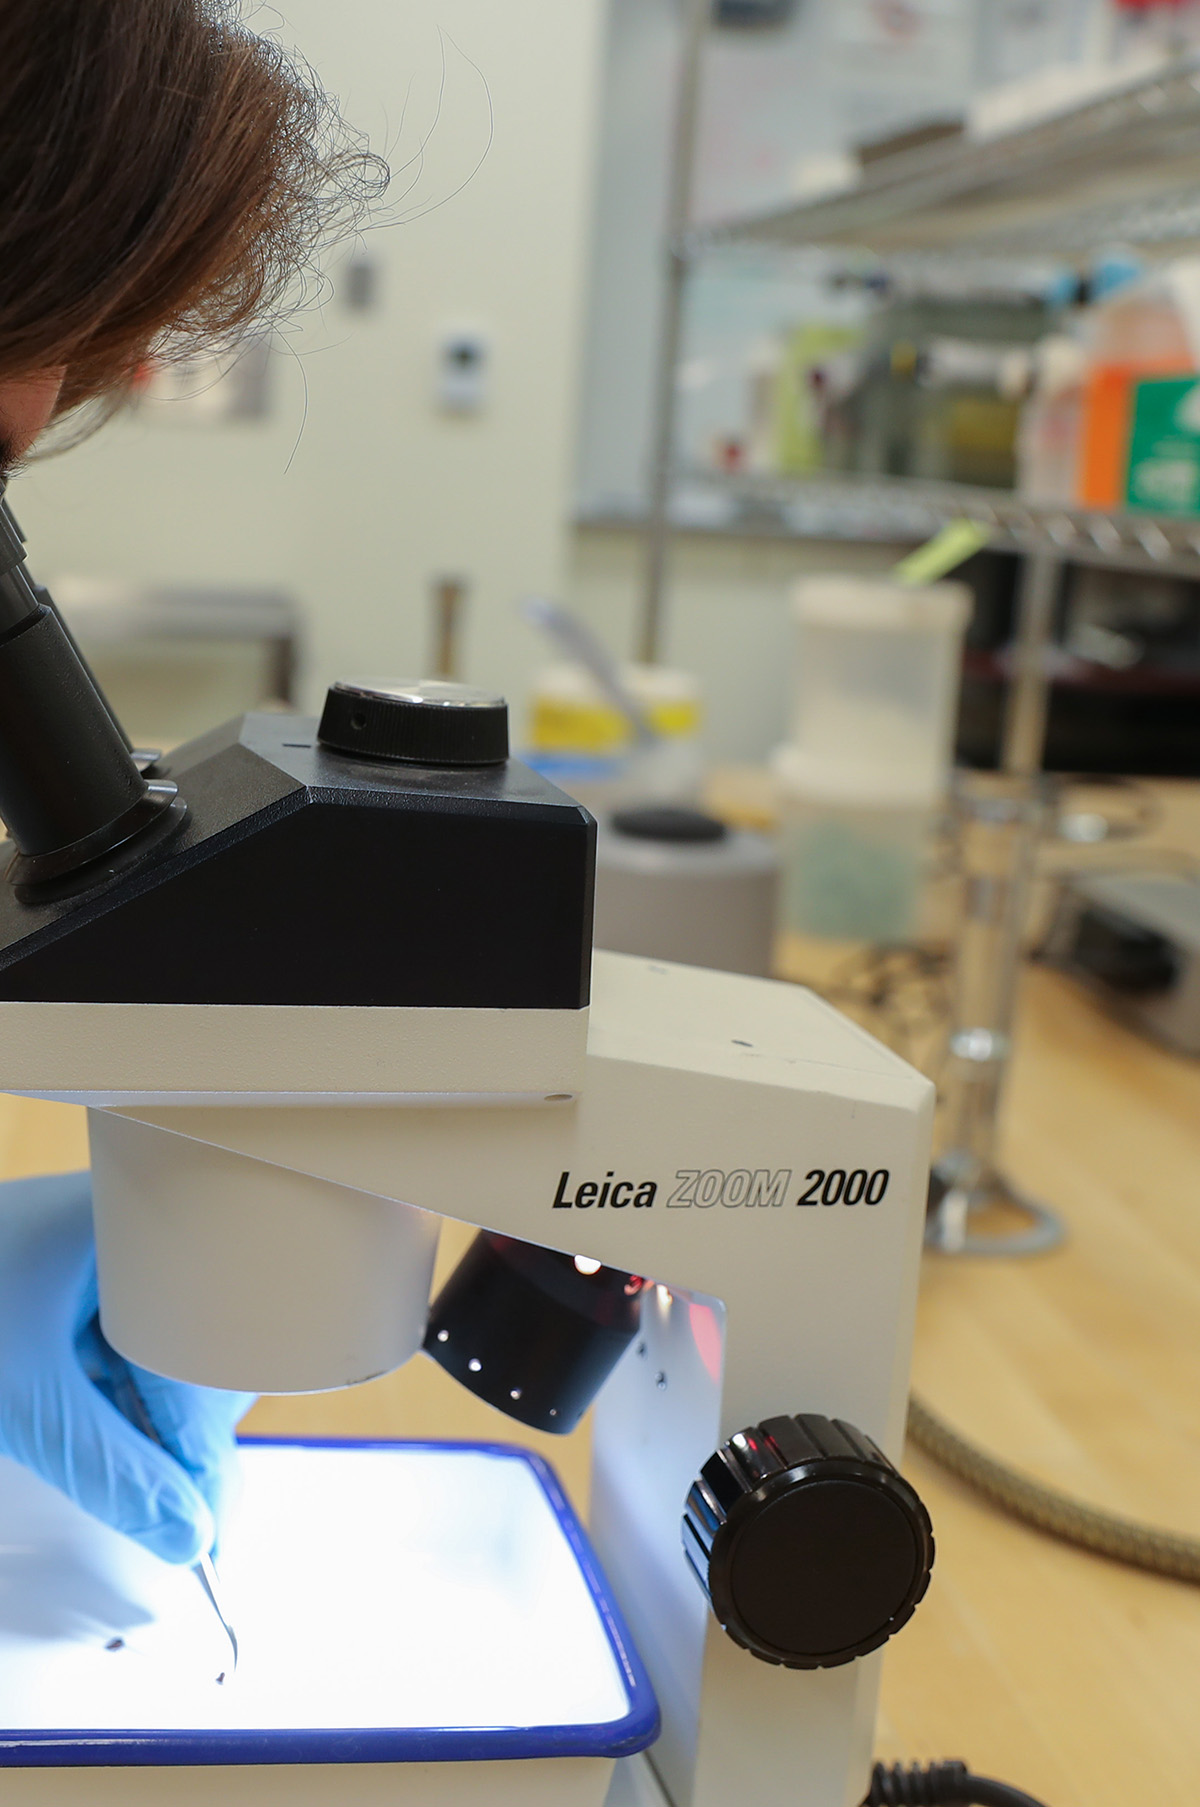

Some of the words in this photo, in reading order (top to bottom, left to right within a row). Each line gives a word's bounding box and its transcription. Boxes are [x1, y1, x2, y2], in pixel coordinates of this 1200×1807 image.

[552, 1170, 658, 1209] Leica
[666, 1169, 792, 1209] ZOOM
[796, 1168, 890, 1207] 2000
